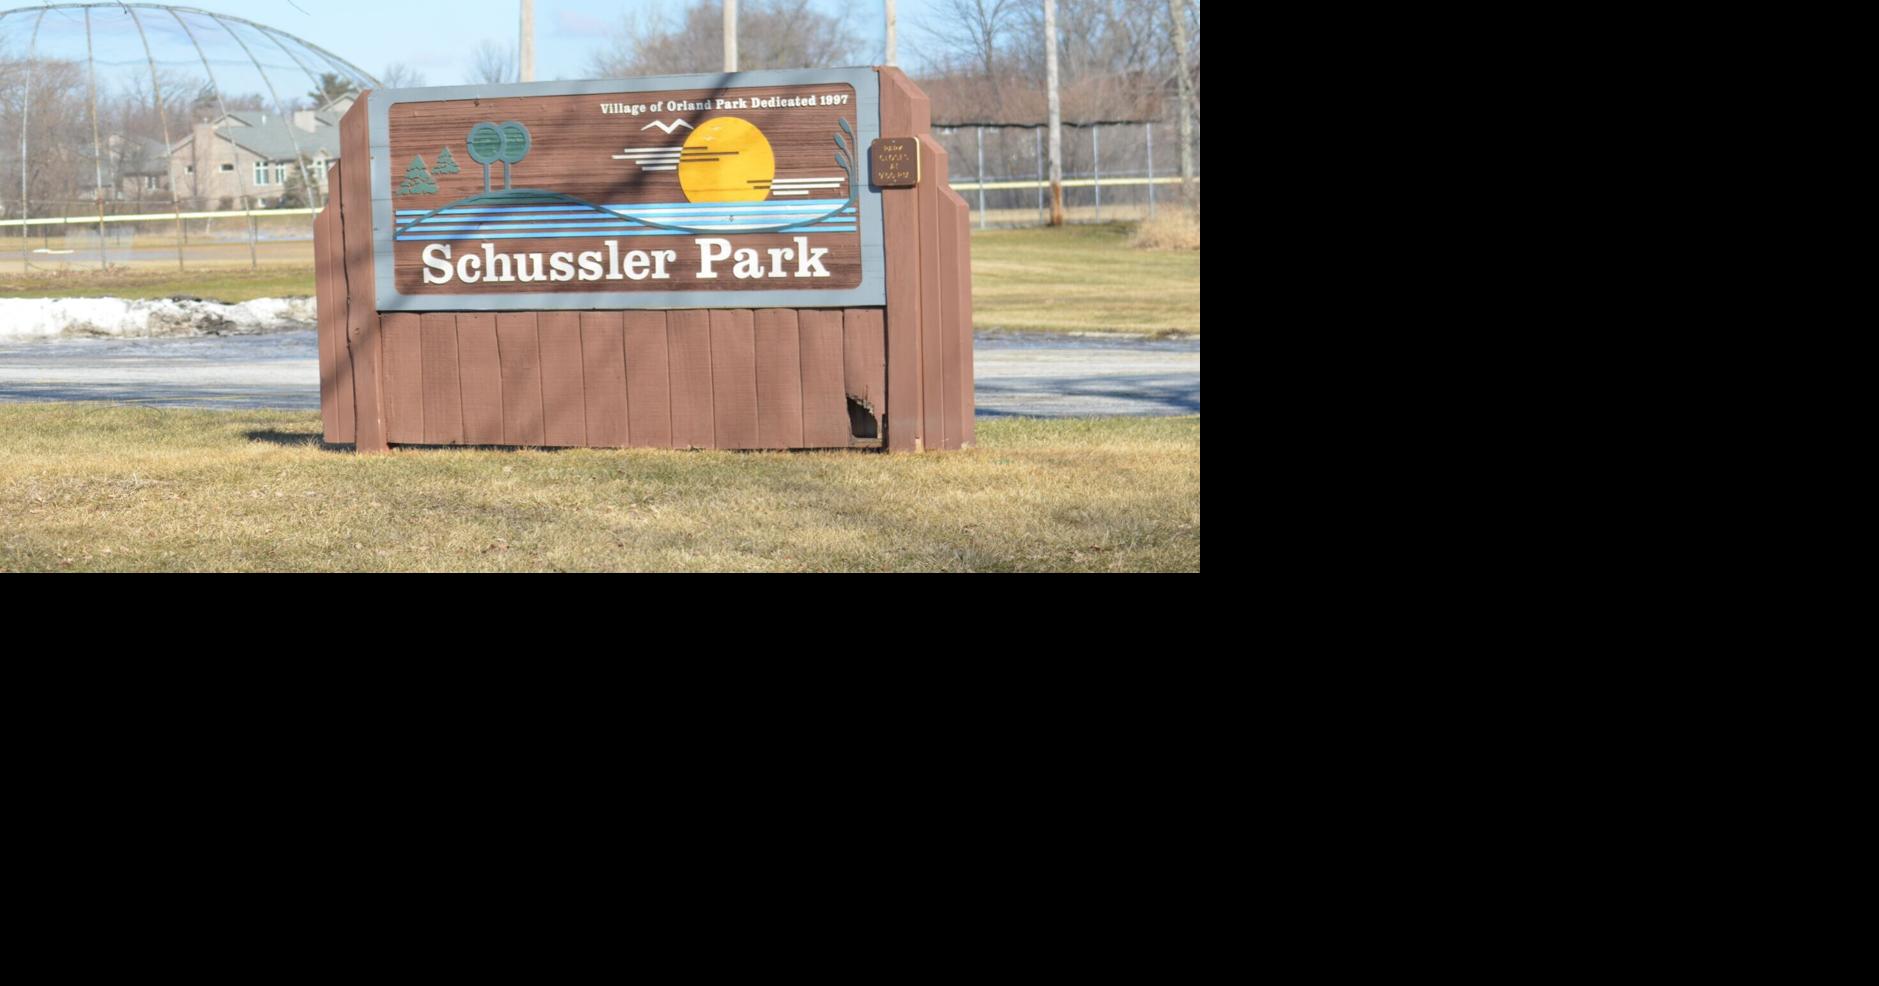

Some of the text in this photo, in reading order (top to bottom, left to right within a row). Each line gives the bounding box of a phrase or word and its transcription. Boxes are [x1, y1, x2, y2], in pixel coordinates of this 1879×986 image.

[600, 103, 646, 116] Village
[650, 101, 663, 112] of
[667, 99, 712, 112] Orland
[716, 98, 747, 110] Park
[751, 96, 816, 109] Dedicated
[421, 236, 830, 284] Schussler Park
